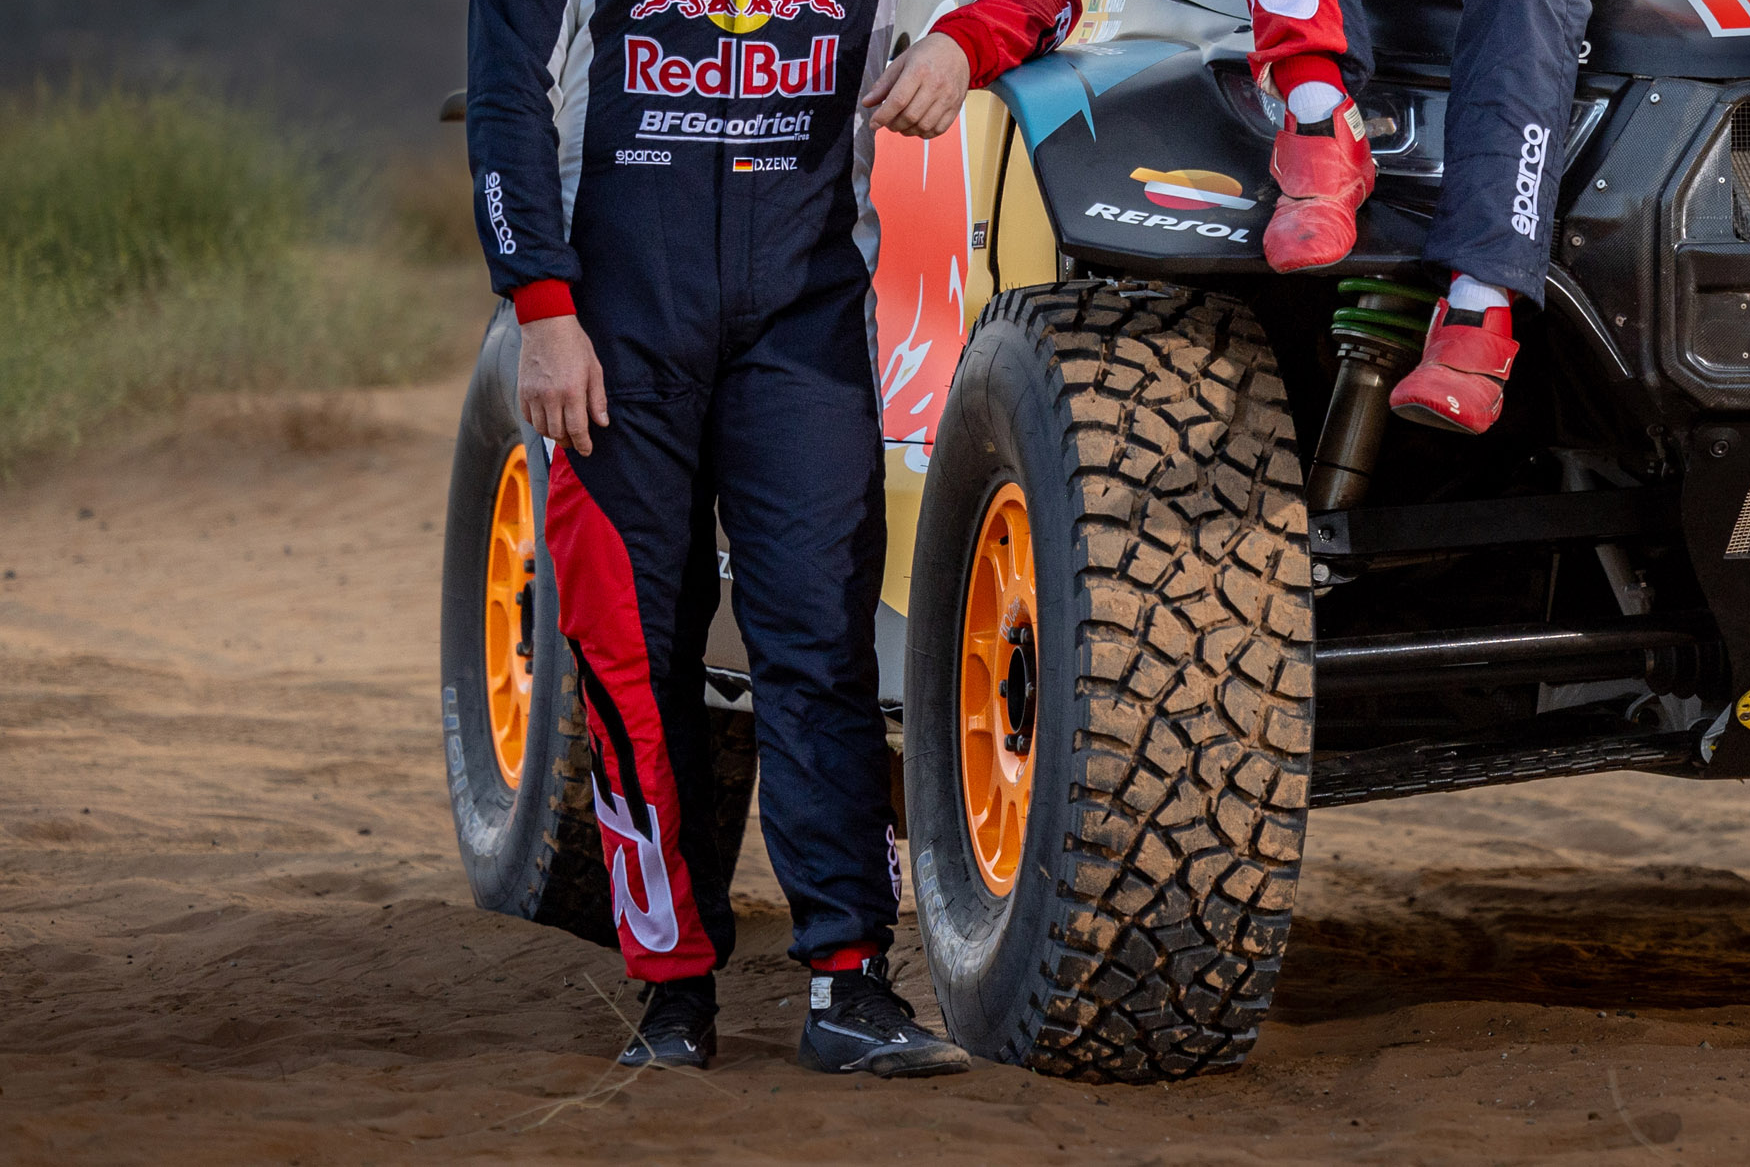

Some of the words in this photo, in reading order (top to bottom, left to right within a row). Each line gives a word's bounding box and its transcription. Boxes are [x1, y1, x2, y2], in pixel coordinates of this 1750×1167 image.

[624, 35, 736, 99] Red
[740, 34, 839, 98] Bull
[639, 110, 812, 136] BFGoodrich
[615, 149, 671, 165] sparco
[754, 157, 798, 172] D.ZENZ
[1511, 123, 1551, 241] sparco
[485, 172, 517, 255] sparco
[1084, 201, 1250, 244] REPSOL
